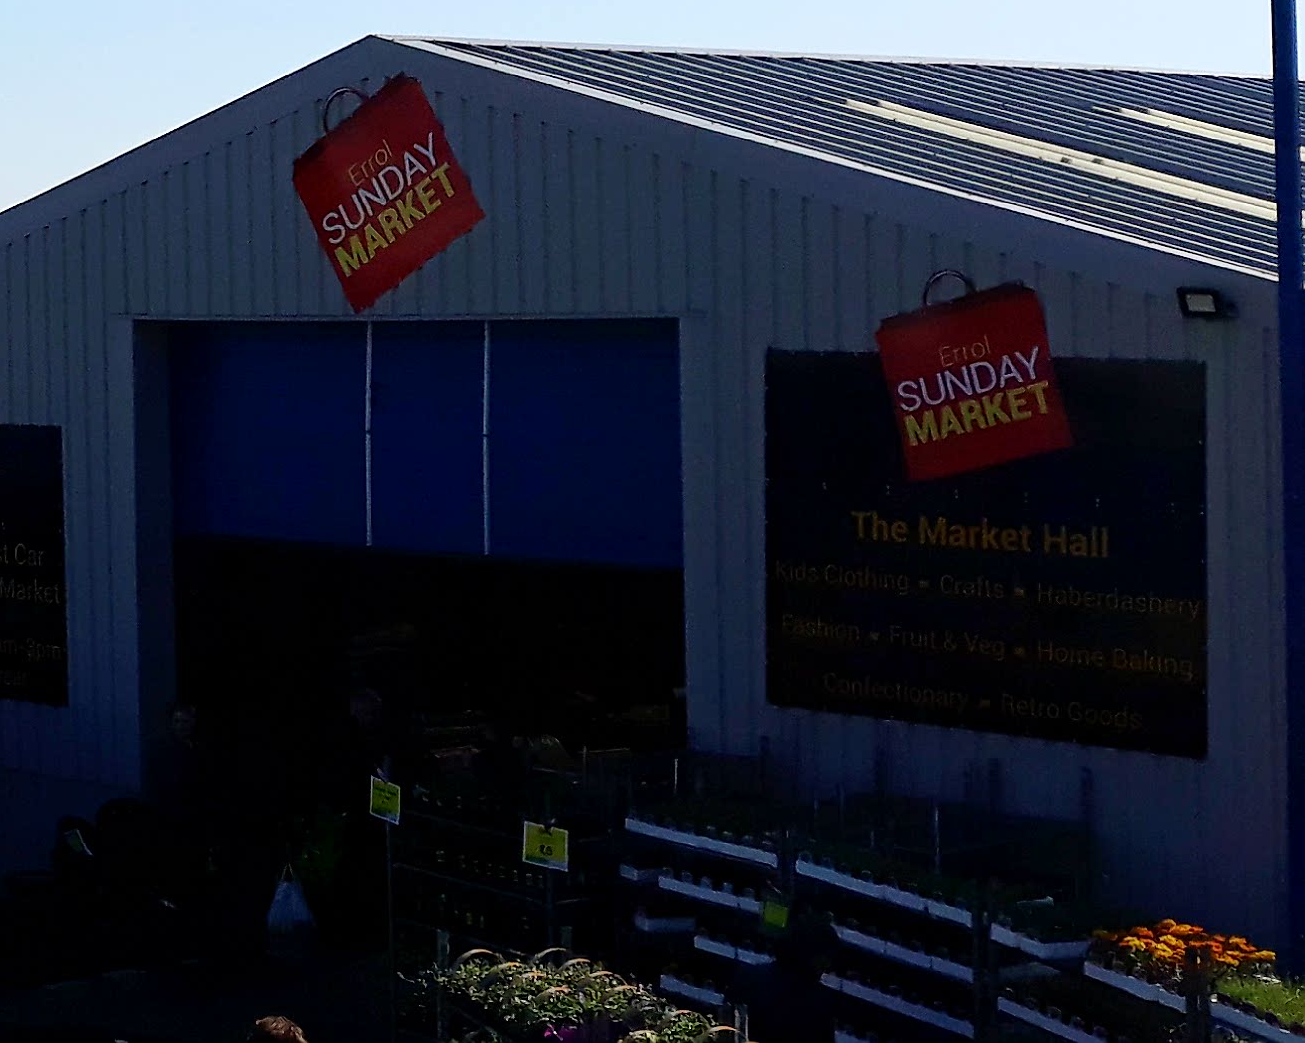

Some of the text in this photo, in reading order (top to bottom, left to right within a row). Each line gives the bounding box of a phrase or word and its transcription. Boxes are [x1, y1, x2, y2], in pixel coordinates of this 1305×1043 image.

[348, 138, 393, 187] Errol
[322, 132, 437, 244] SUNDAY
[333, 162, 456, 278] MARKET
[941, 334, 991, 368] Errol
[897, 346, 1039, 412] SUNDAY
[904, 380, 1049, 446] MARKET
[14, 543, 46, 567] Car
[848, 510, 1111, 558] The Market Hall
[0, 576, 62, 605] Market
[774, 558, 1201, 621] Kids Clothing Crafts Haberdashery
[889, 623, 936, 653] Fruit
[964, 631, 1006, 662] Veg
[1038, 639, 1104, 665] Home
